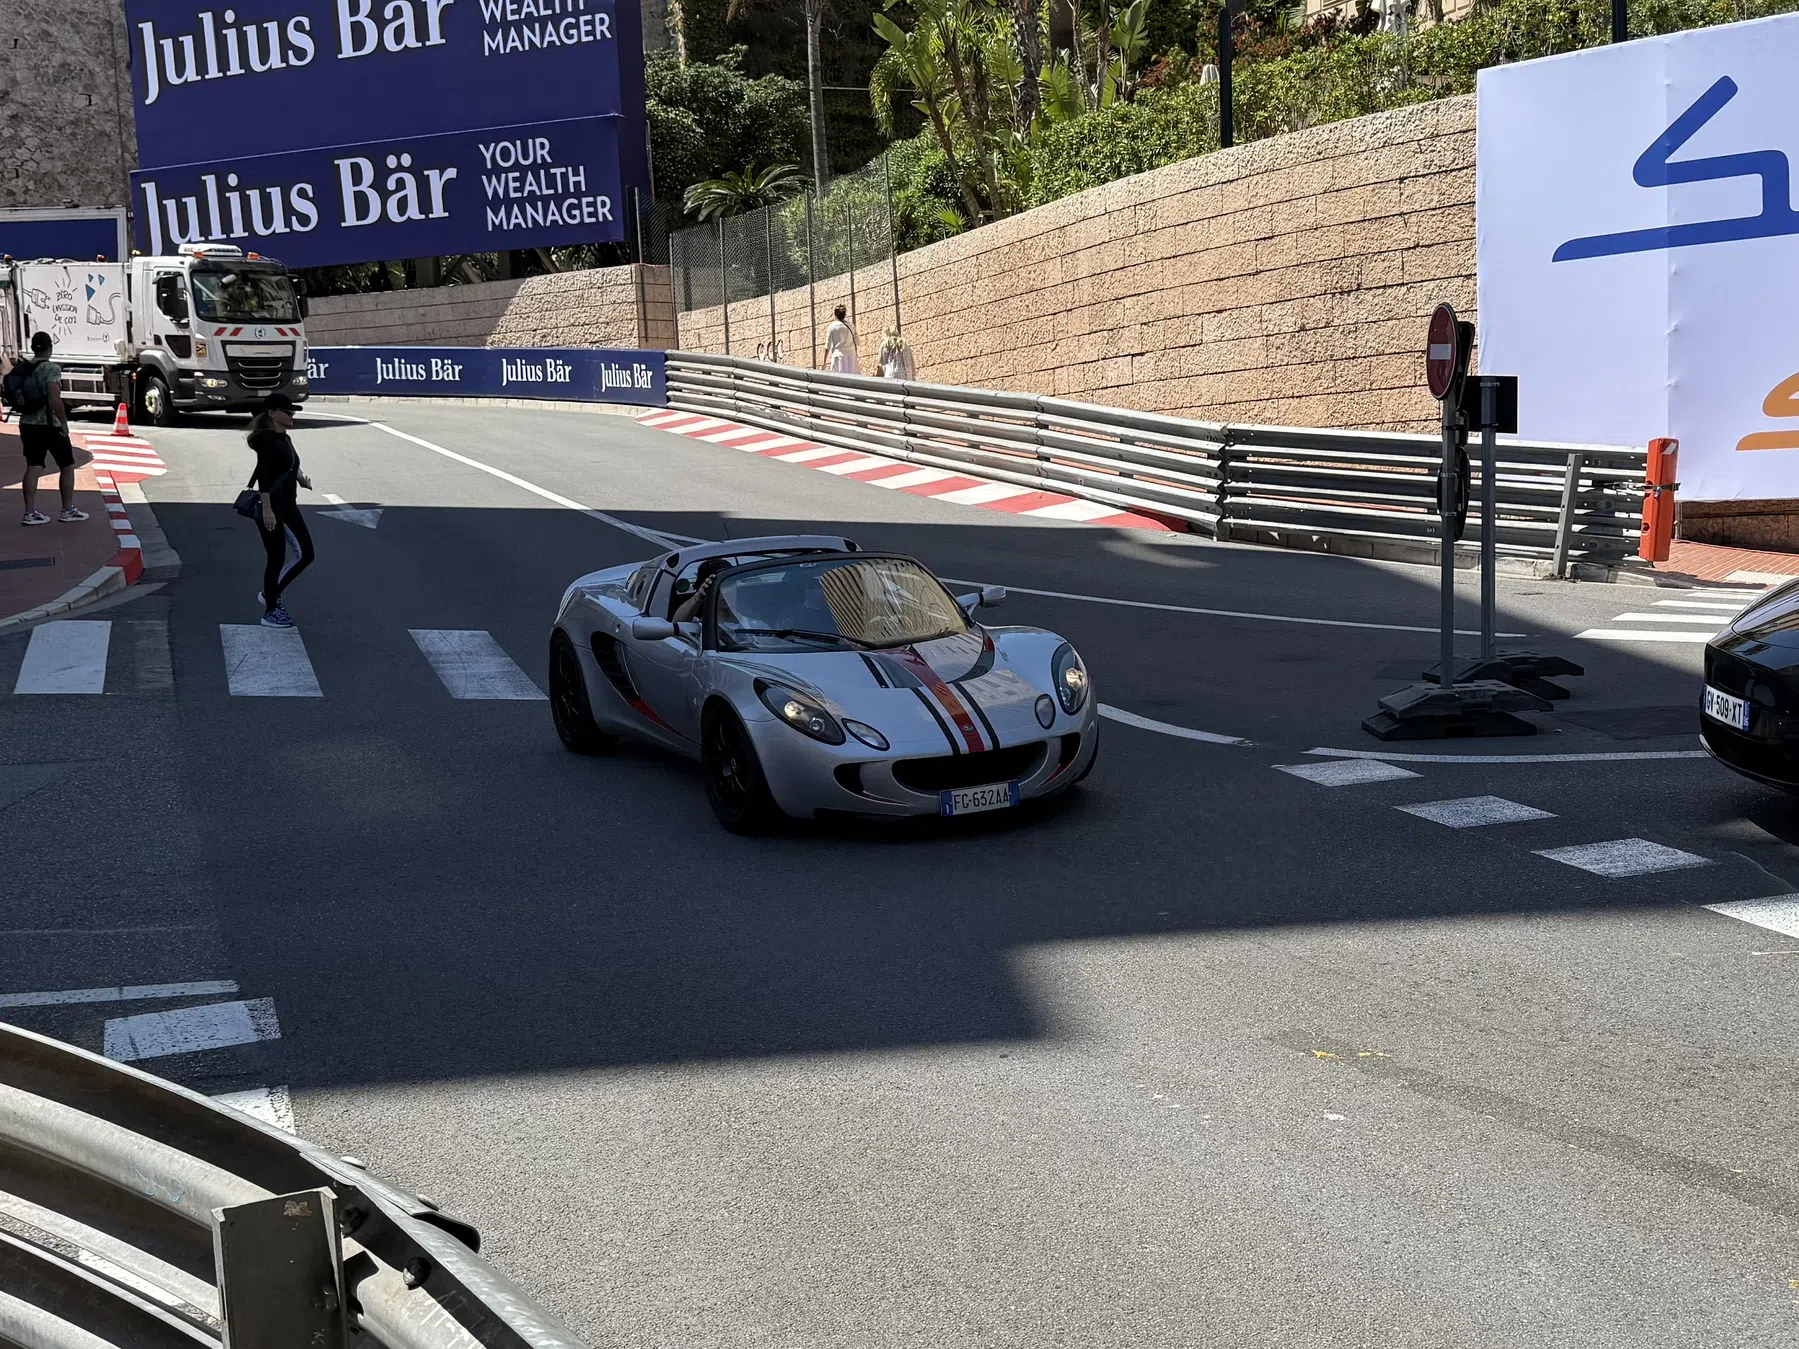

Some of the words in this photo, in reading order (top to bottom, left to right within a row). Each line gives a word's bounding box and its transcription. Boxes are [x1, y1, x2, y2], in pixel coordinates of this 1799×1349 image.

[483, 13, 612, 56] MANAGER
[138, 9, 315, 105] Julius
[478, 137, 552, 169] YOUR
[481, 165, 586, 200] WEALTH
[140, 172, 319, 257] Julius
[334, 152, 458, 228] Bär
[486, 195, 613, 231] MANAGER
[307, 358, 329, 379] är
[376, 357, 426, 385] Julius
[431, 358, 463, 381] Bär
[501, 358, 543, 386] Julius
[546, 358, 572, 383] Bär
[601, 362, 632, 393] Julius
[633, 363, 653, 389] Bär
